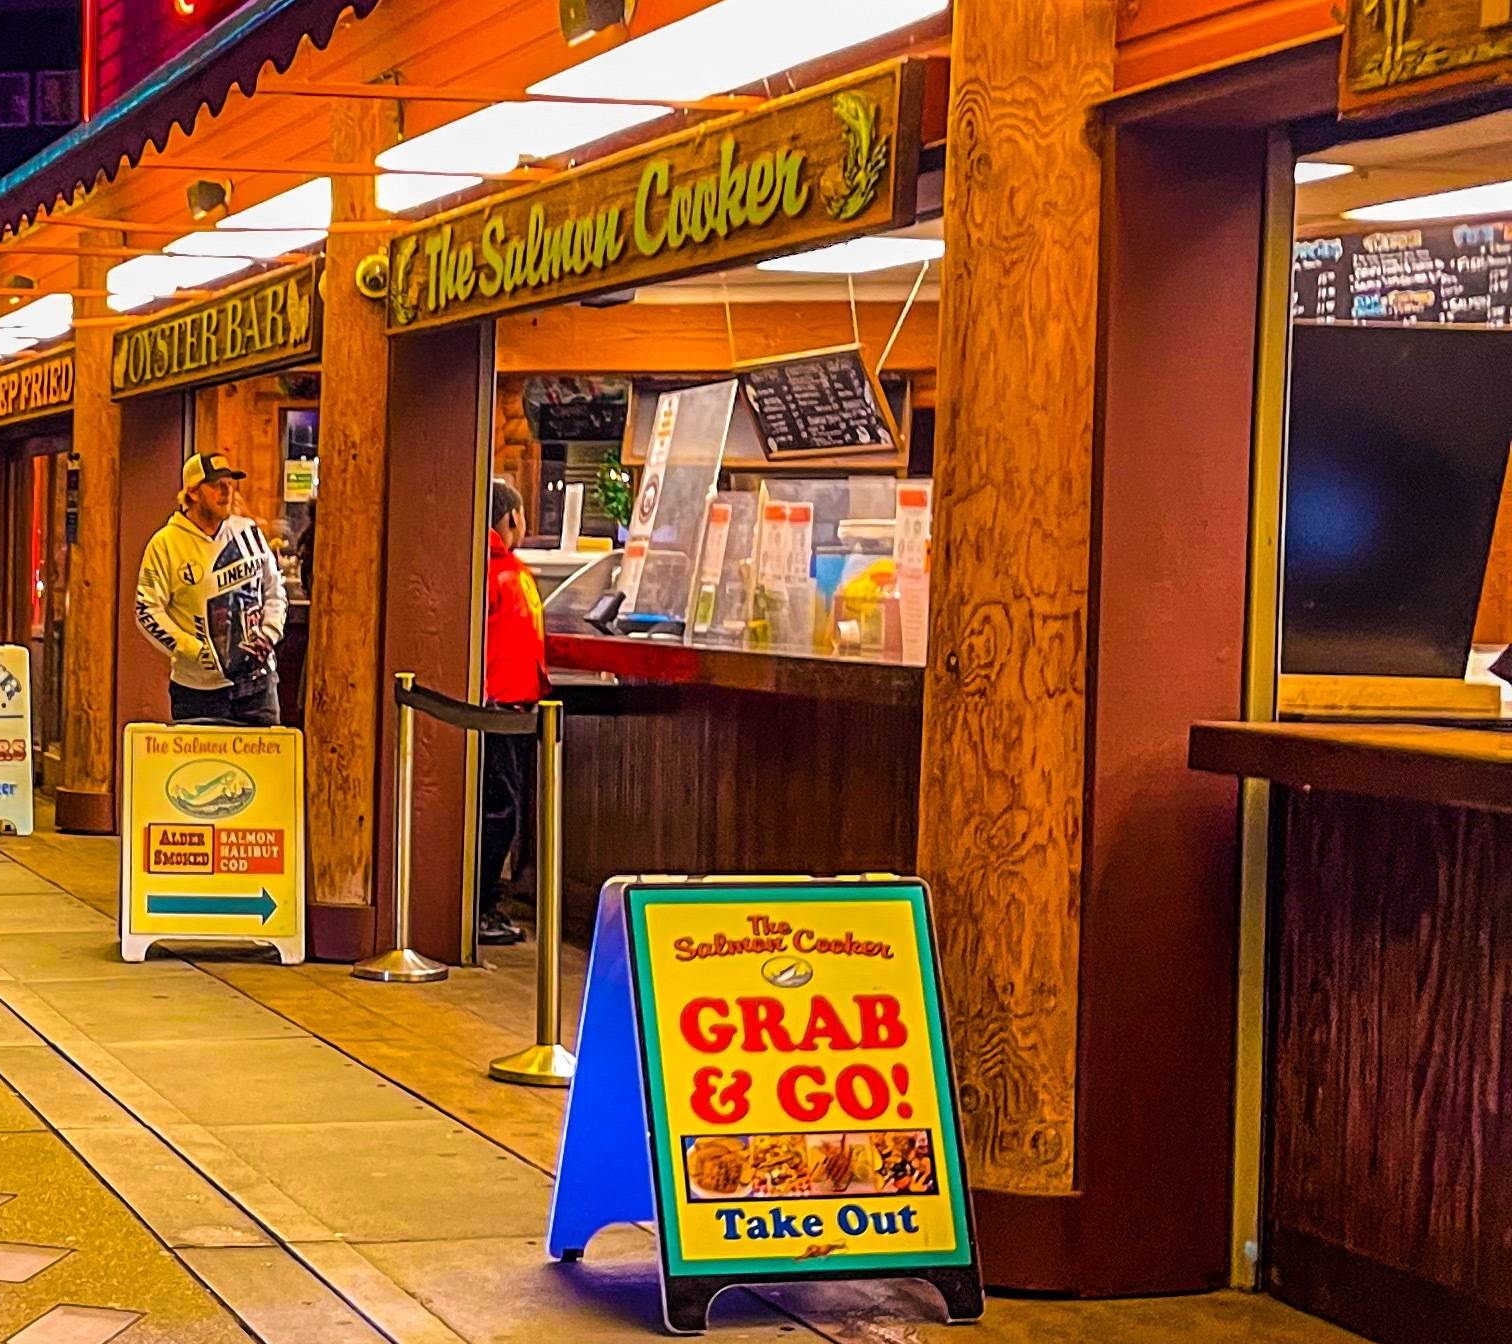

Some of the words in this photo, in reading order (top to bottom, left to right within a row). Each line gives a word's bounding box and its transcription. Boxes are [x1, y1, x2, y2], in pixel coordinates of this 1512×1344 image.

[424, 224, 476, 312] The
[478, 203, 625, 298] Salmon
[634, 135, 810, 256] Cooker
[129, 310, 218, 385] OYSTER
[225, 285, 287, 359] BAR
[20, 358, 74, 411] FRIED
[145, 736, 169, 754] The
[173, 736, 228, 754] Salmon
[232, 736, 281, 754] Cooker
[220, 831, 276, 844] SALMON
[220, 845, 279, 858] HALIBUT
[220, 859, 248, 872] COD
[746, 914, 792, 936] The
[674, 933, 788, 962] Salmon
[792, 928, 894, 960] Cooker
[679, 994, 909, 1054] GRAB
[690, 1066, 752, 1125] &
[776, 1063, 915, 1123] GO!
[715, 1207, 824, 1242] Take
[837, 1203, 919, 1236] Out
